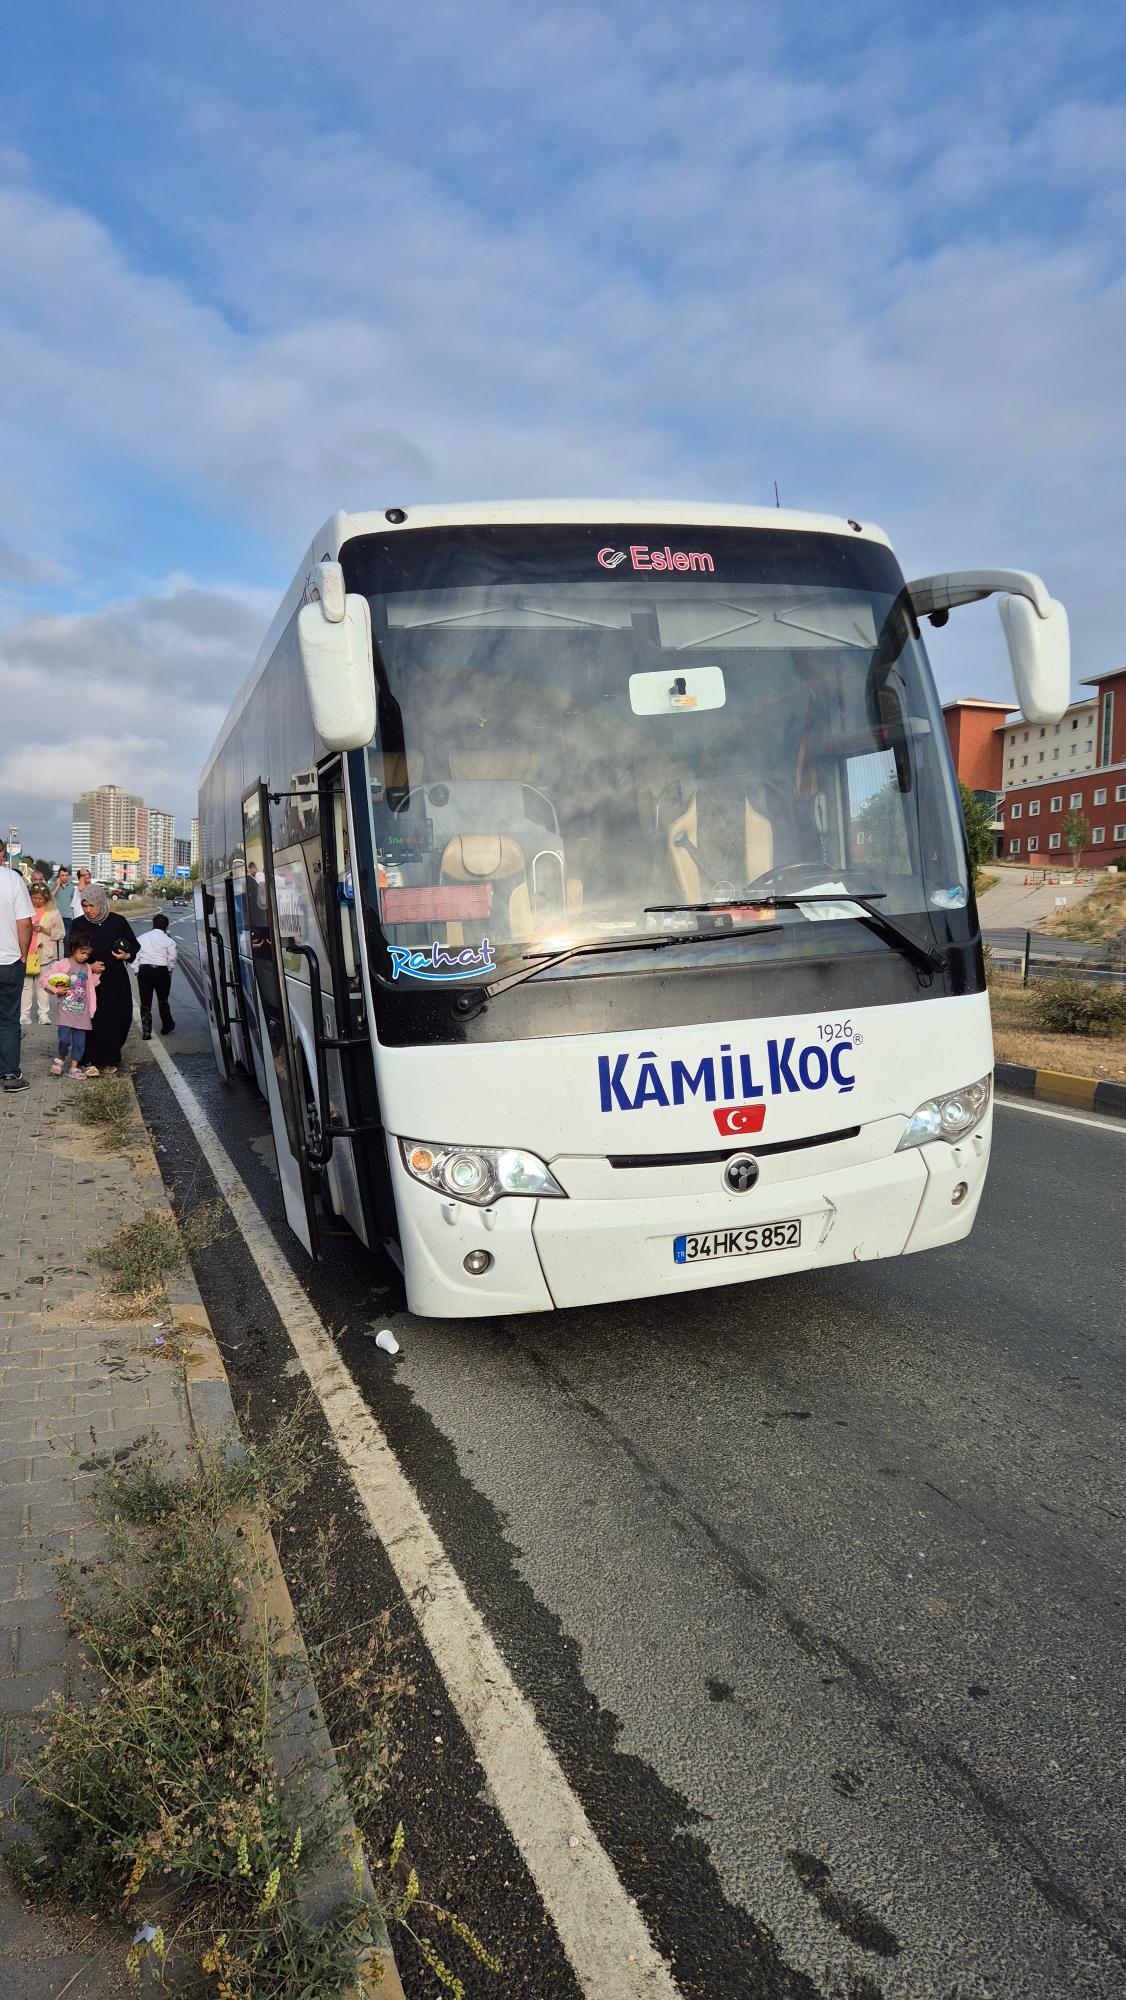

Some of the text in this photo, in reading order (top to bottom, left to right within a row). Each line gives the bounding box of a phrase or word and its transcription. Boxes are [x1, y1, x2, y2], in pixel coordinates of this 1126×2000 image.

[630, 546, 715, 571] Eslem
[387, 938, 496, 980] Rahat
[817, 1019, 853, 1043] 1926
[598, 1037, 855, 1112] KÂMİL KOÇ
